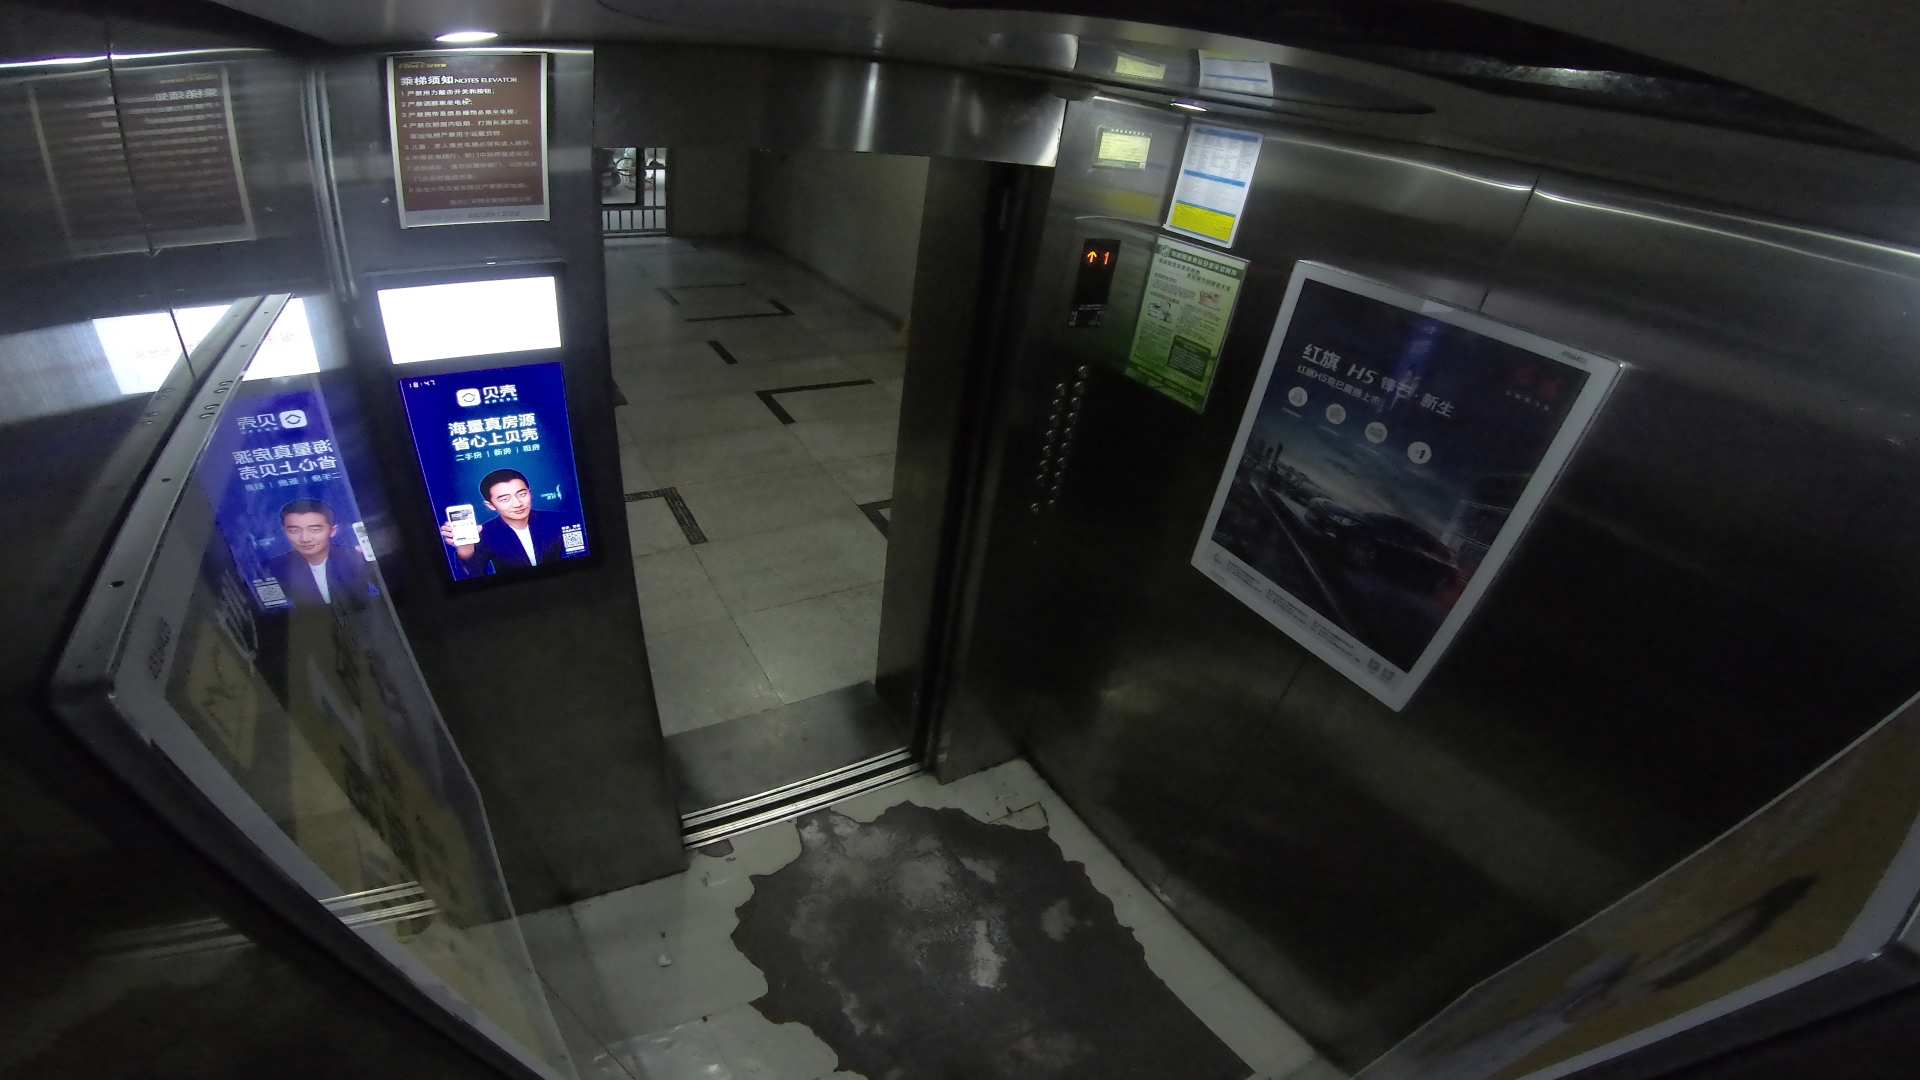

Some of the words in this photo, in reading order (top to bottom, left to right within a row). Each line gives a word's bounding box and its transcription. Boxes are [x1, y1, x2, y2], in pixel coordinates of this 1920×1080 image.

[400, 75, 454, 86] 乘梯须知
[1302, 343, 1341, 372] 红旗
[1347, 364, 1379, 384] H5
[482, 384, 518, 399] 贝壳
[448, 412, 537, 437] 海量真房源
[452, 427, 540, 451] 省心上贝壳
